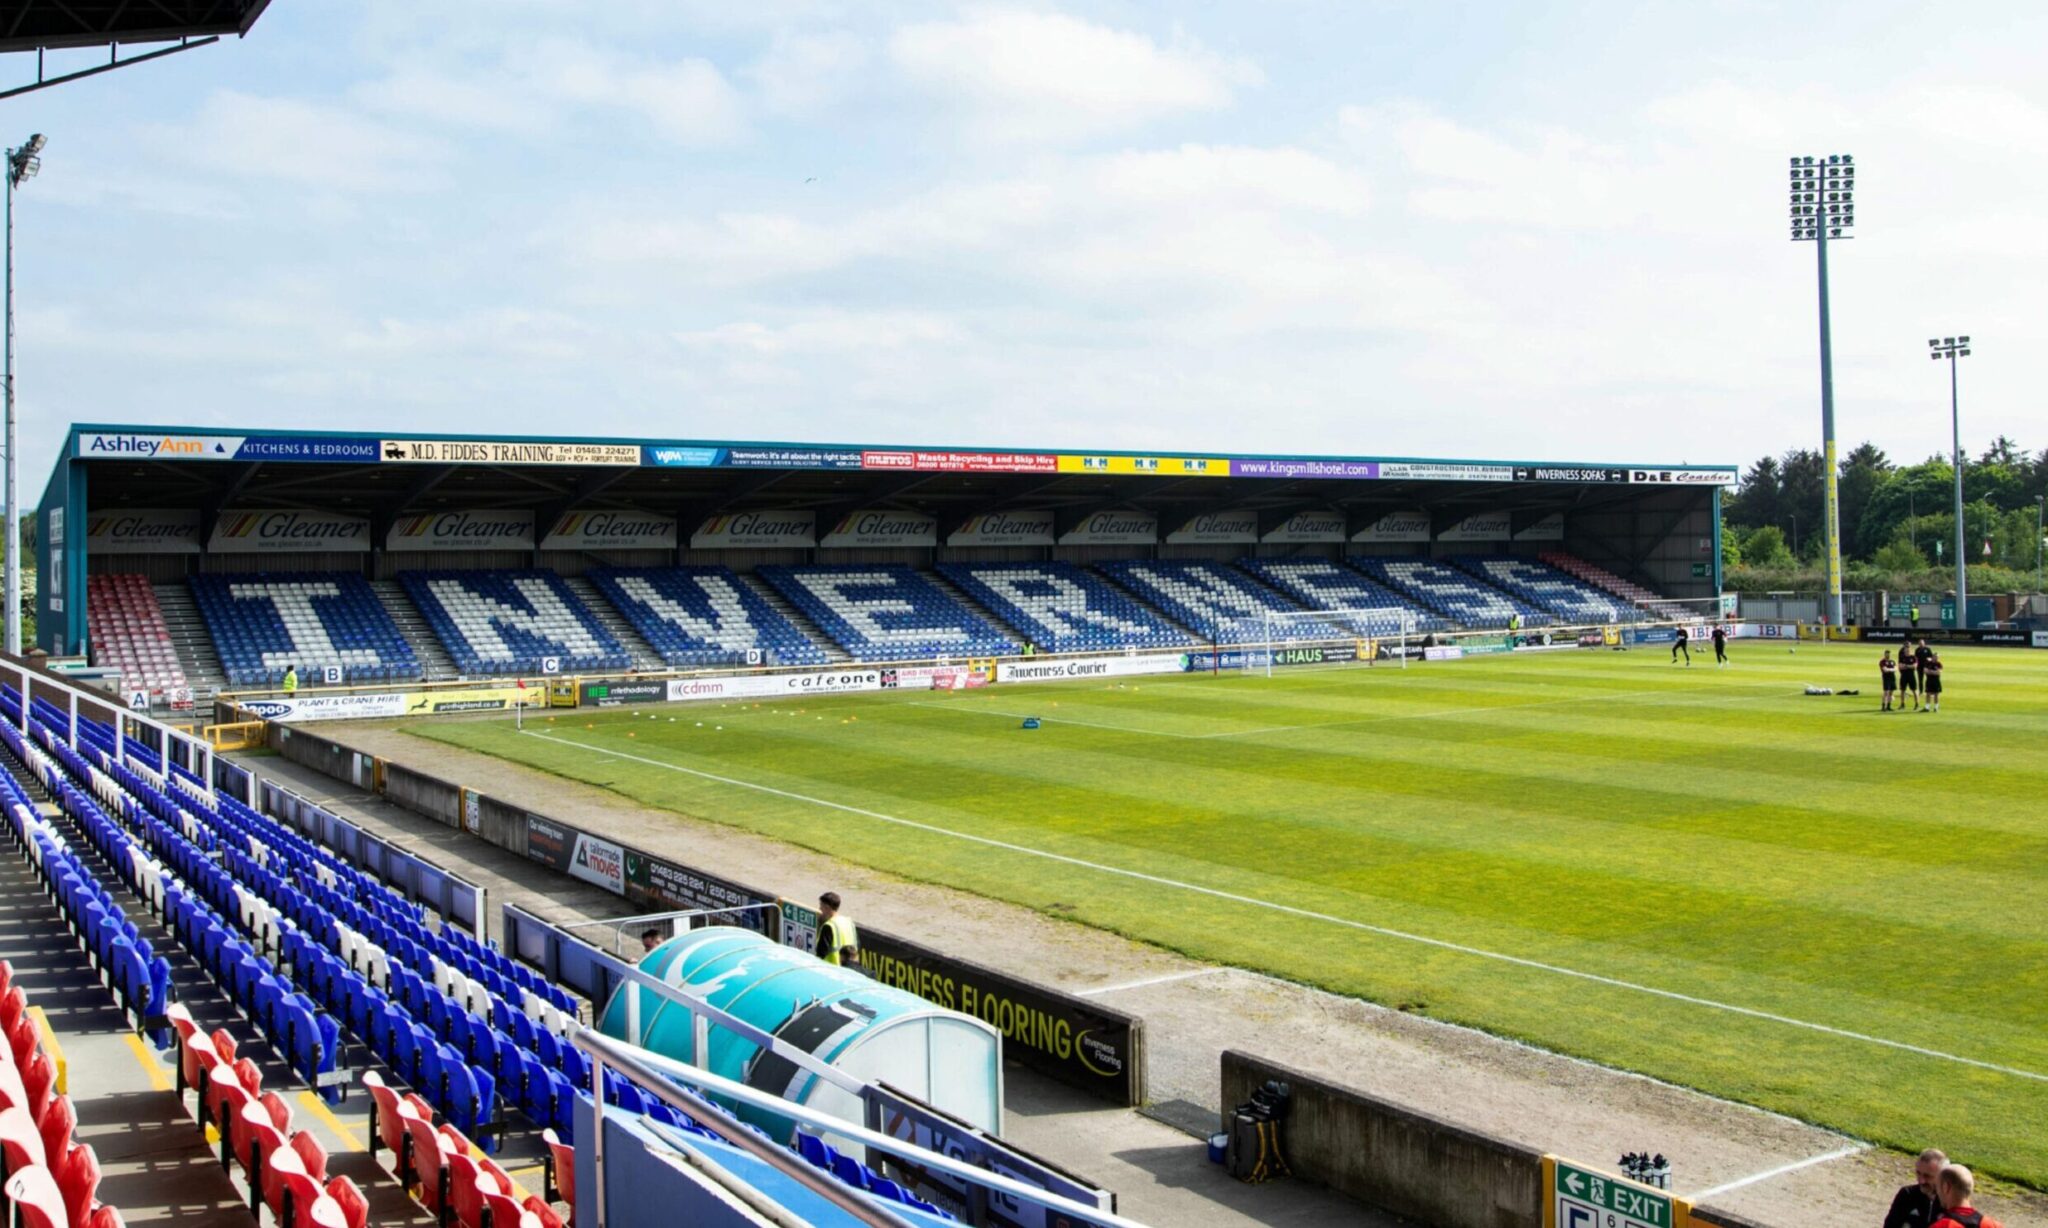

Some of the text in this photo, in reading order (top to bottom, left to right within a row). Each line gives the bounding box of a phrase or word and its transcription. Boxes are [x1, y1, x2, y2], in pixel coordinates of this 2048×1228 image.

[243, 443, 374, 456] KITCHENS & BEDROOMS
[411, 443, 553, 462] M.D. FIDDES TRAINING
[559, 446, 635, 455] Tel 01463 224271
[791, 453, 811, 461] about
[813, 453, 822, 461] the
[823, 453, 839, 463] right
[867, 456, 912, 466] munros
[918, 454, 947, 462] Waste
[950, 455, 992, 466] Recycling
[1014, 457, 1034, 467] Skip
[1240, 462, 1368, 476] www.kingsmillshotel.com
[1536, 470, 1606, 481] INVERNESS SOFAS
[112, 517, 199, 537] Gleaner
[259, 512, 368, 538] Gleaner
[433, 513, 533, 537] Gleaner
[583, 513, 674, 536] Gleaner
[729, 513, 813, 536] Gleaner
[857, 513, 935, 535] Gleaner
[980, 513, 1053, 534] Gleaner
[1089, 513, 1155, 534] Gleaner
[1195, 514, 1256, 533] Gleaner
[1287, 515, 1344, 532] Gleaner
[1376, 514, 1428, 533] Gleaner
[1460, 516, 1510, 532] Gleaner
[1692, 627, 1709, 638] IBI
[1759, 625, 1782, 637] IBI
[749, 651, 758, 662] D
[1286, 649, 1323, 663] HAUS
[545, 659, 556, 671] C
[918, 668, 954, 676] PROJECTS
[1006, 662, 1107, 679] Inverness Courier
[328, 668, 338, 680] B
[611, 685, 661, 695] methodology
[682, 682, 723, 696] cdmm
[133, 692, 145, 706] A
[297, 695, 400, 707] PLANT & CRANE HIRE
[590, 842, 620, 863] tailormade
[589, 854, 620, 880] moves
[673, 871, 688, 886] 225
[799, 909, 815, 926] EXIT
[861, 947, 955, 1010] NVERNESS
[1084, 1035, 1116, 1055] Inverness
[1095, 1049, 1122, 1070] Flooring
[1613, 1187, 1664, 1224] EXIT
[1607, 1214, 1616, 1228] 6
